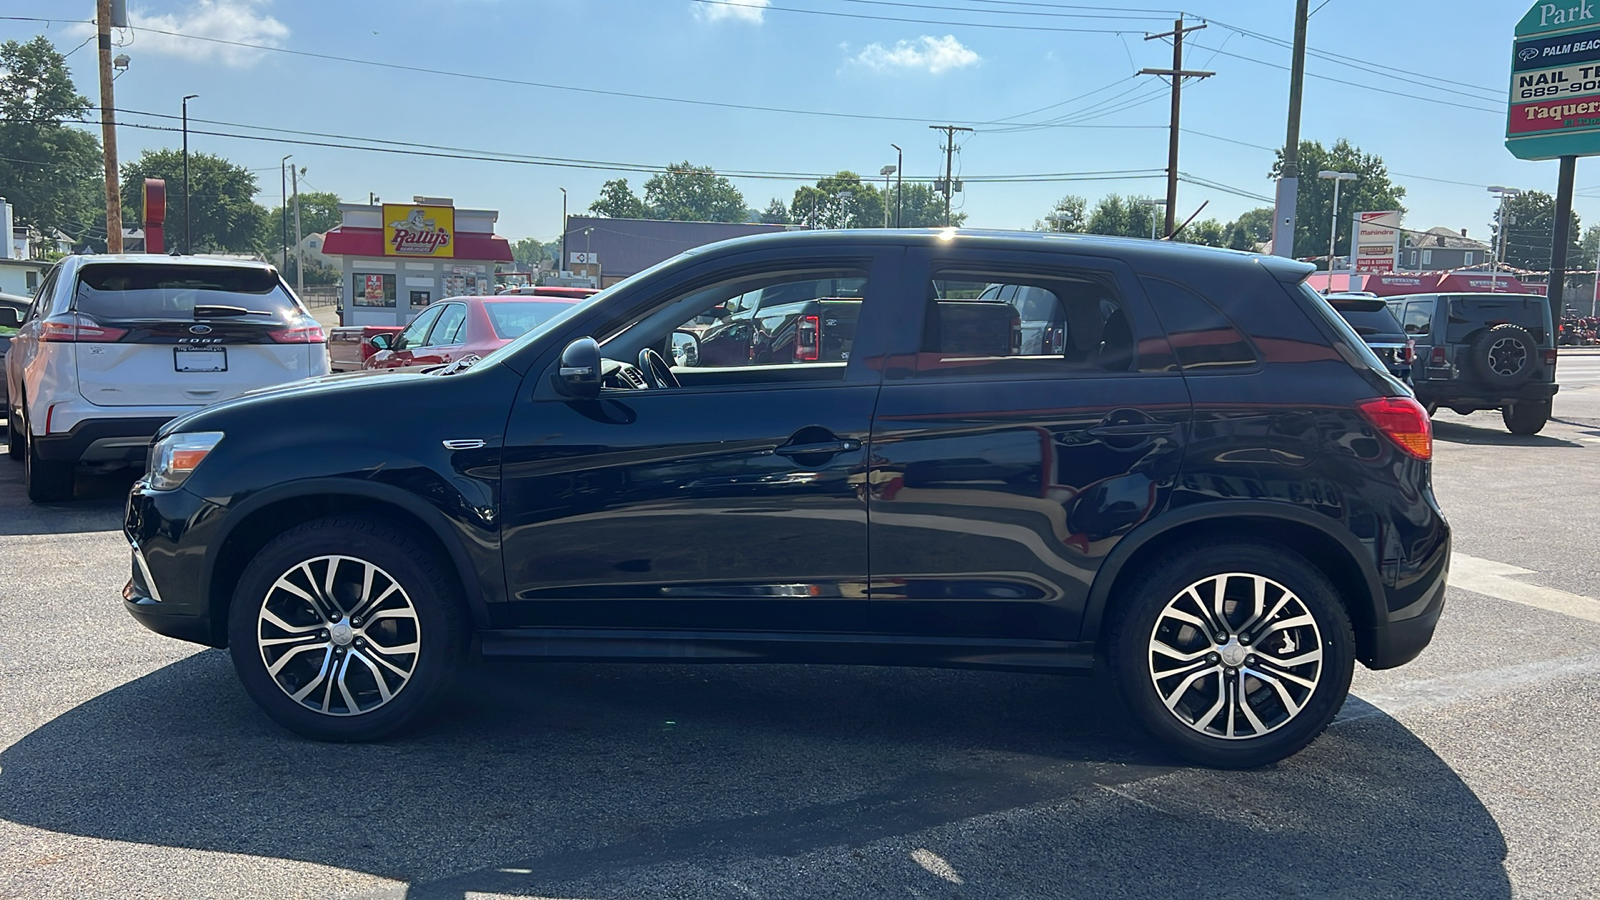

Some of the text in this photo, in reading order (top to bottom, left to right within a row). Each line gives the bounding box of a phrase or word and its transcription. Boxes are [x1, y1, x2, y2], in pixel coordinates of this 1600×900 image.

[1539, 0, 1594, 26] Park
[1542, 43, 1571, 57] PALM
[1519, 70, 1569, 88] NAIL
[1524, 101, 1600, 121] Taquer
[391, 227, 449, 252] Rally's
